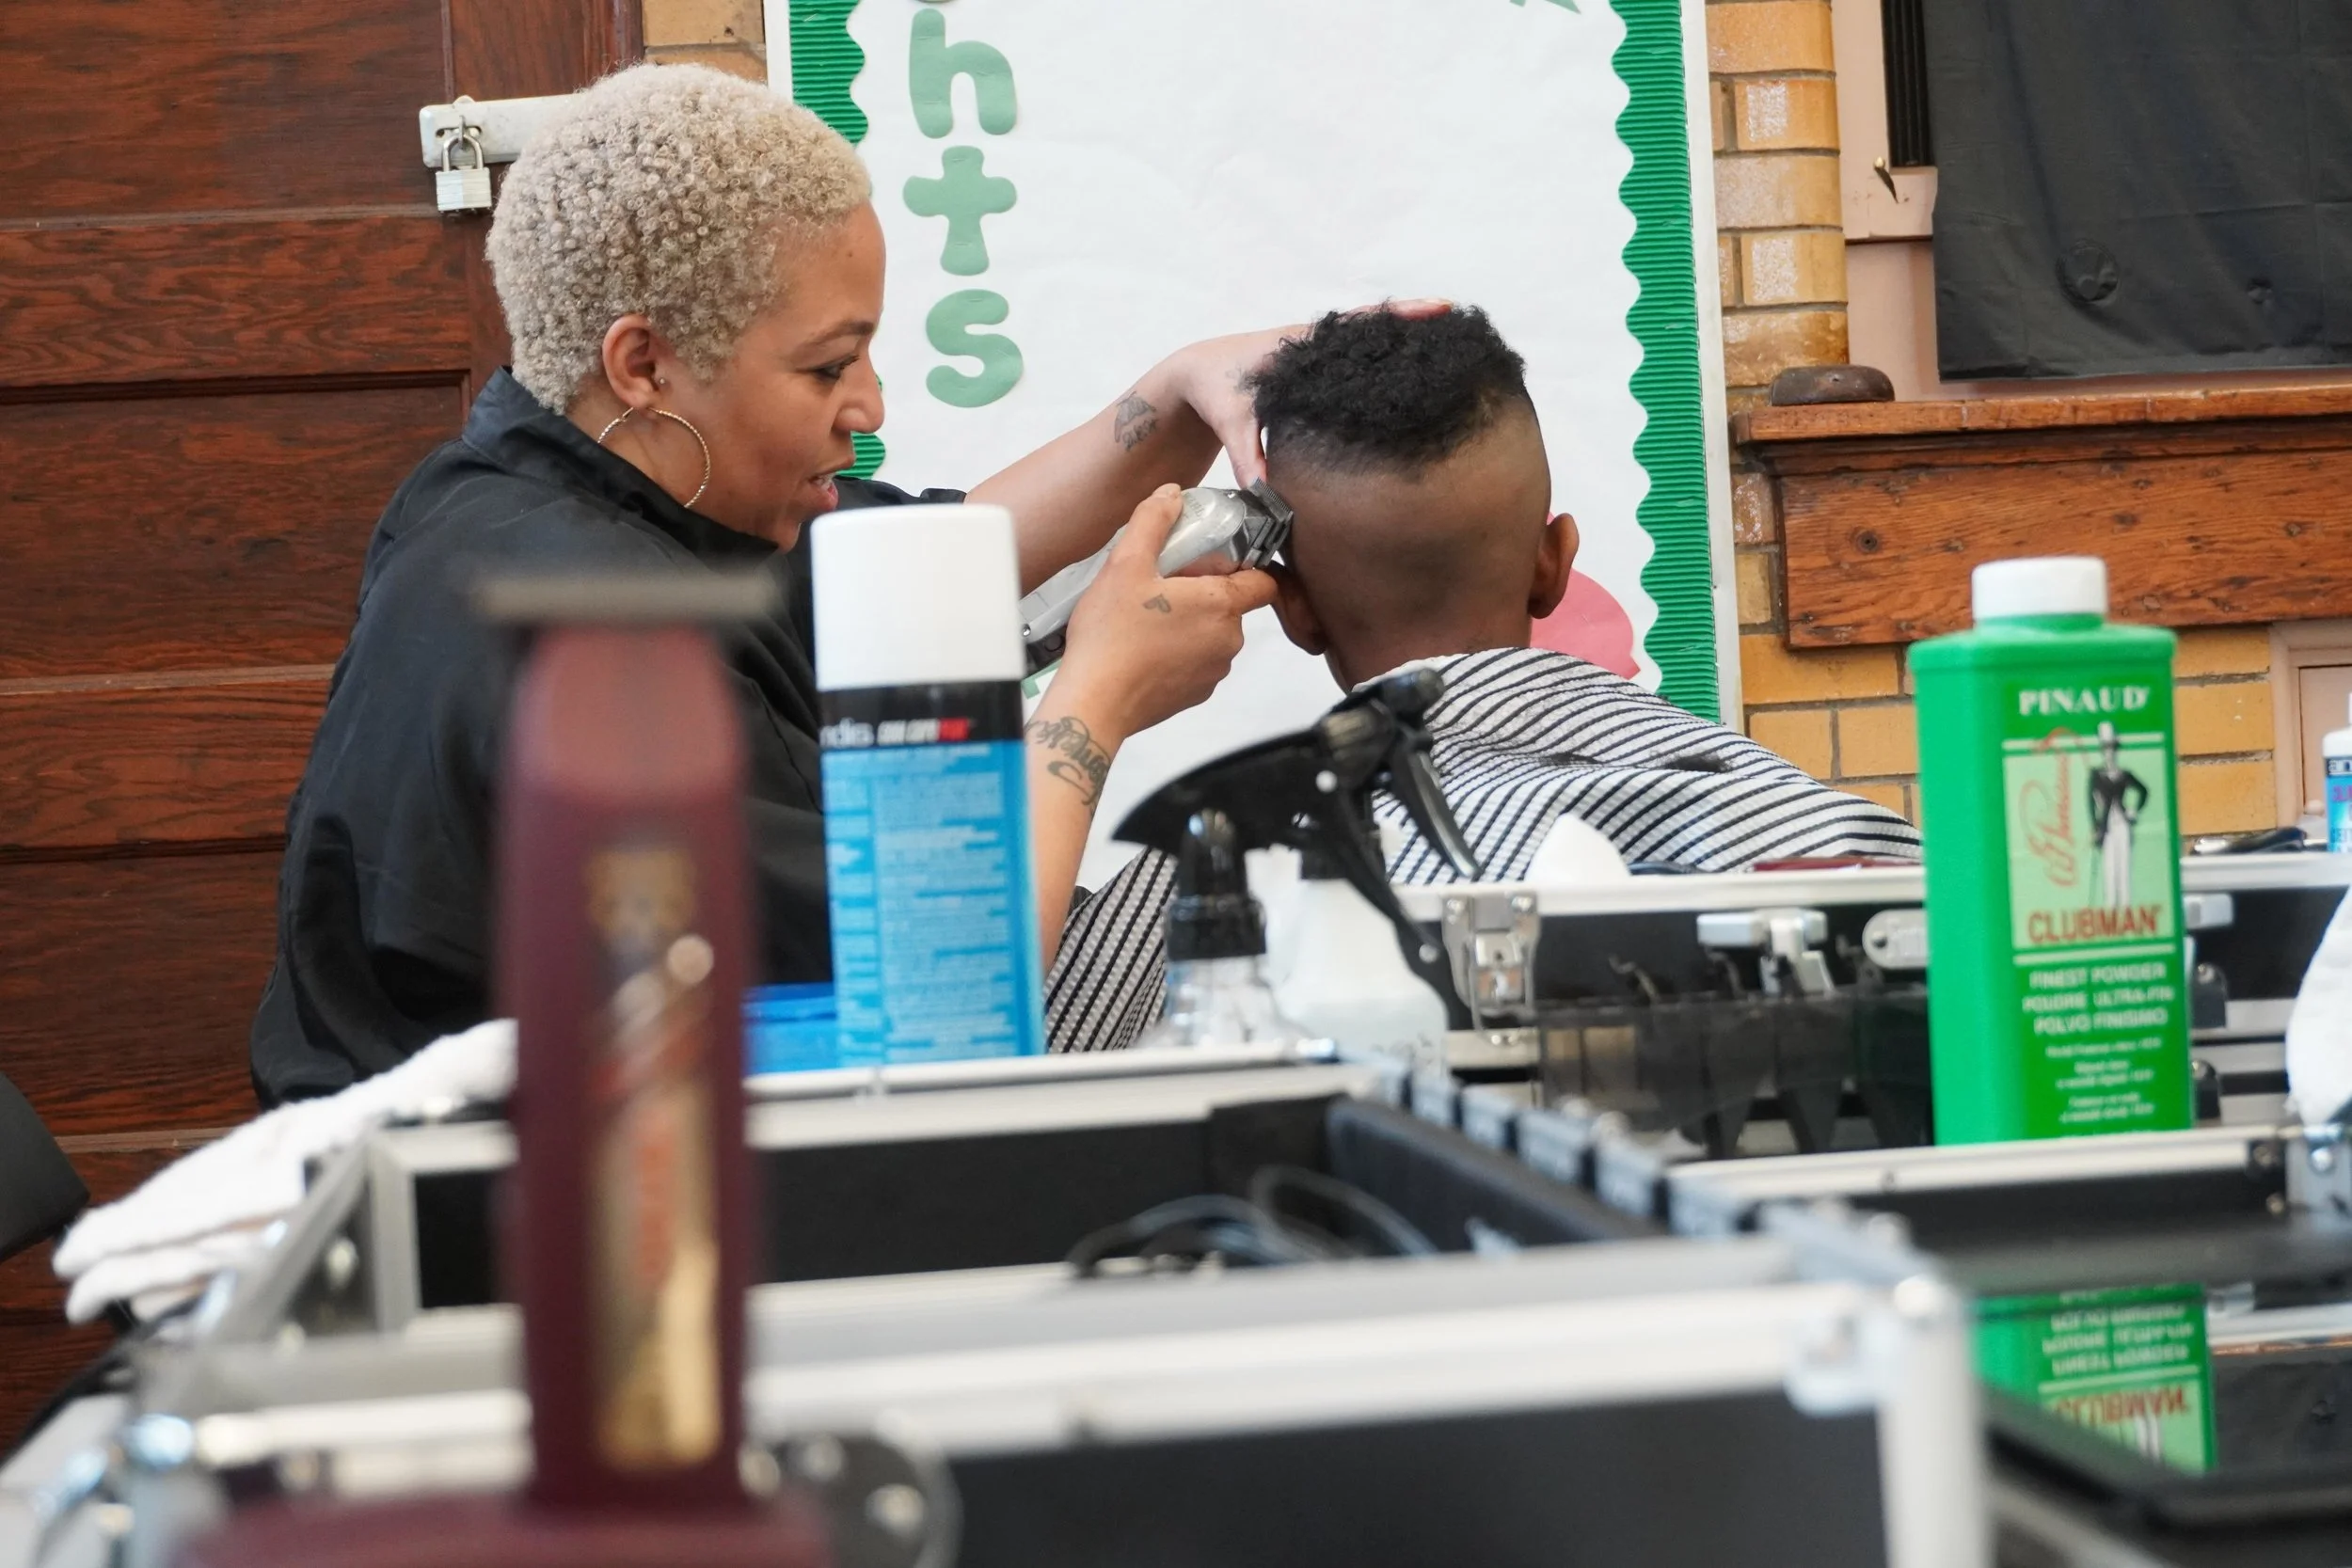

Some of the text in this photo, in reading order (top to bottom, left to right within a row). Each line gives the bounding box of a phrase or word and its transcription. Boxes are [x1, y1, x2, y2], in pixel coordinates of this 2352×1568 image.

[903, 0, 1024, 407] hts
[2019, 685, 2150, 716] PINAUD
[819, 717, 875, 750] ndis
[2027, 905, 2161, 943] CLUBMAN
[2029, 961, 2167, 989] FINEST POWDER
[2022, 990, 2088, 1013] POUDRE
[2033, 1013, 2091, 1037] POLVO
